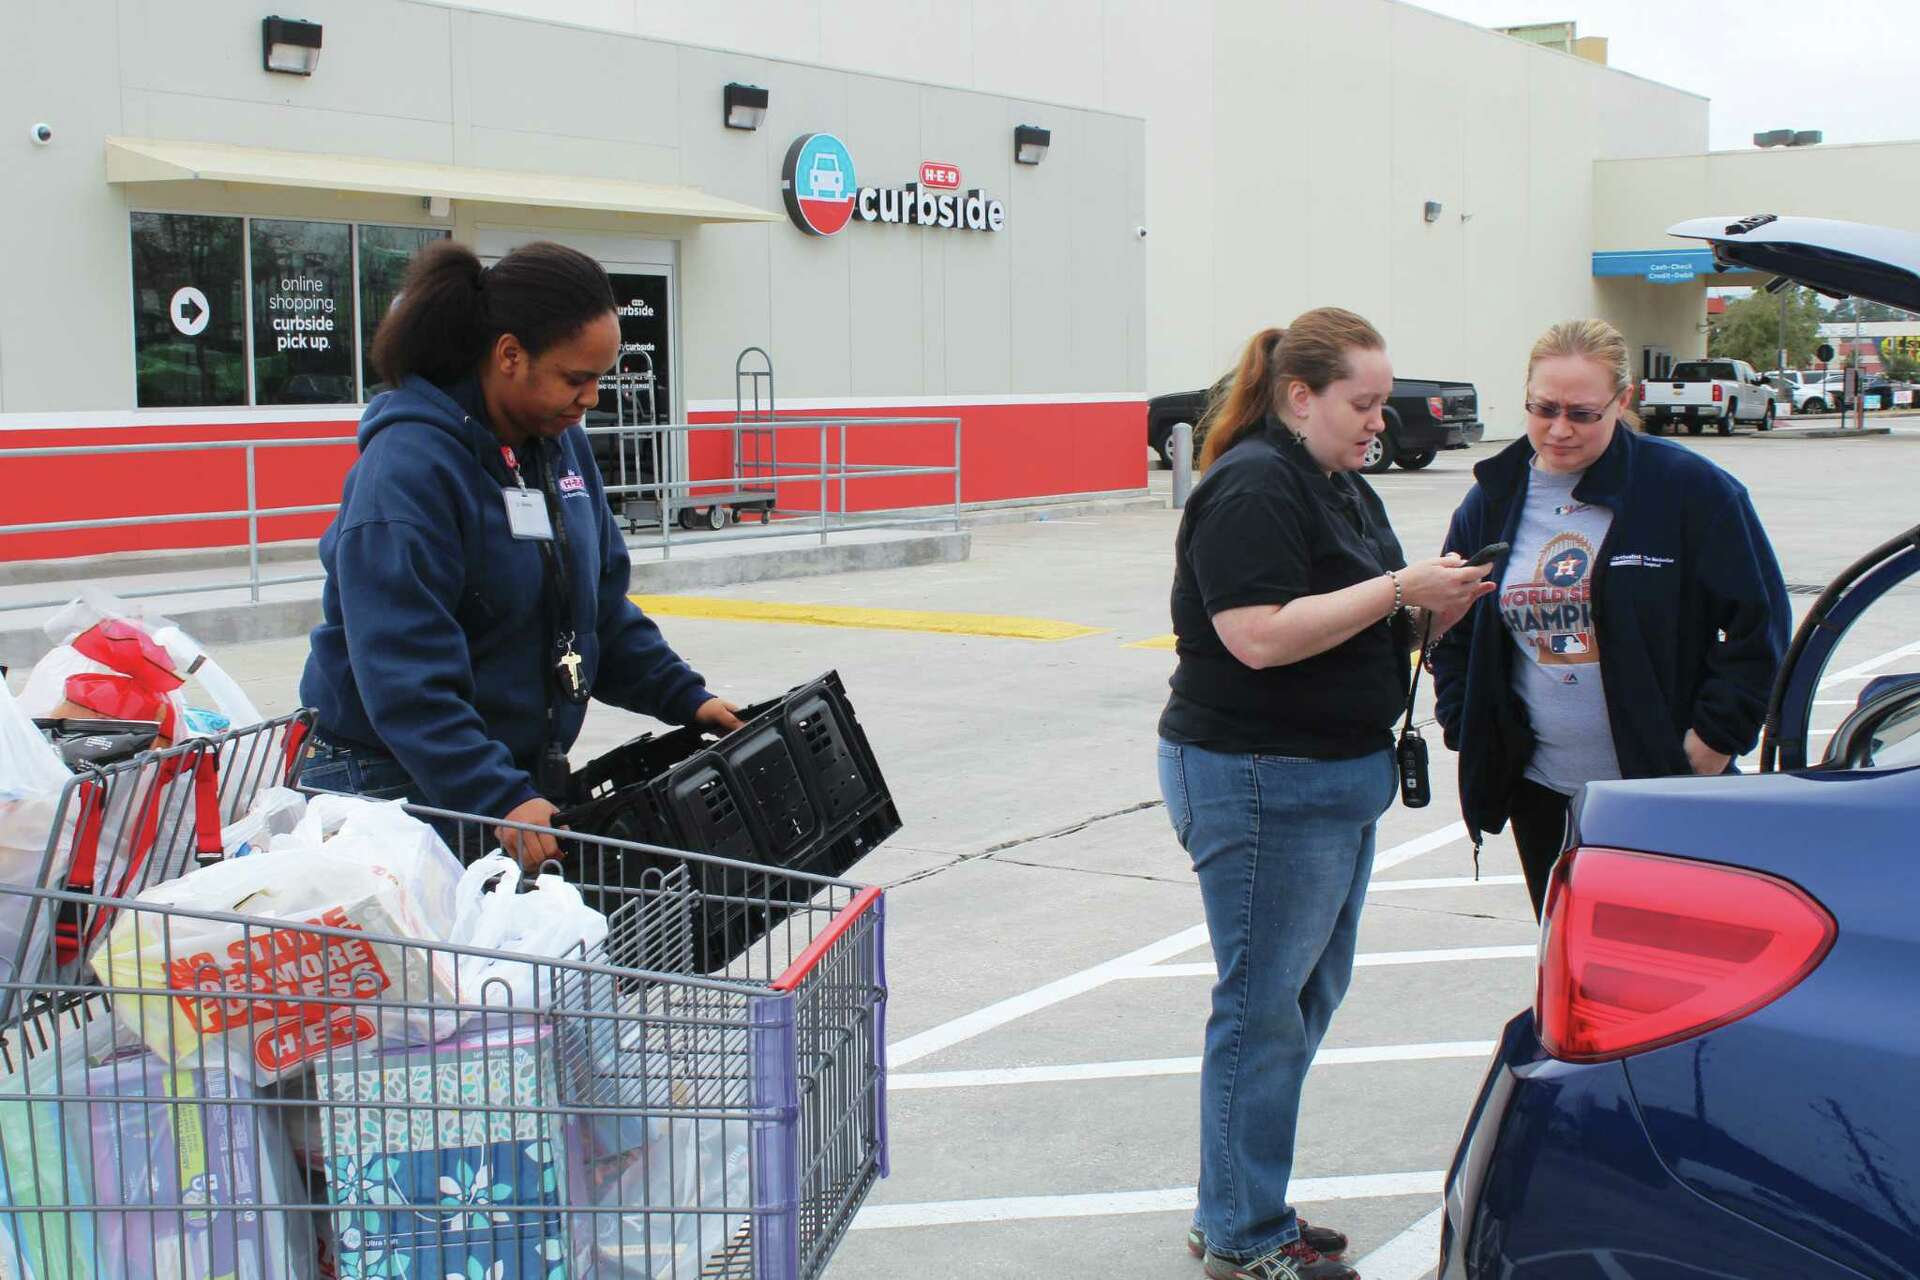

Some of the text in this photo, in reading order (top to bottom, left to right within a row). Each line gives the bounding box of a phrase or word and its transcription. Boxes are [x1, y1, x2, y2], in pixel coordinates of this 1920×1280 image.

[925, 168, 957, 183] H-E-B
[858, 184, 1005, 232] curbside
[281, 276, 323, 292] online
[269, 294, 336, 313] shopping.
[617, 305, 654, 317] urbside
[273, 316, 334, 331] curbside
[277, 333, 331, 351] pick up.
[1501, 585, 1590, 607] WORLD SE
[1503, 603, 1590, 632] HAMPI
[266, 940, 369, 985] MORE
